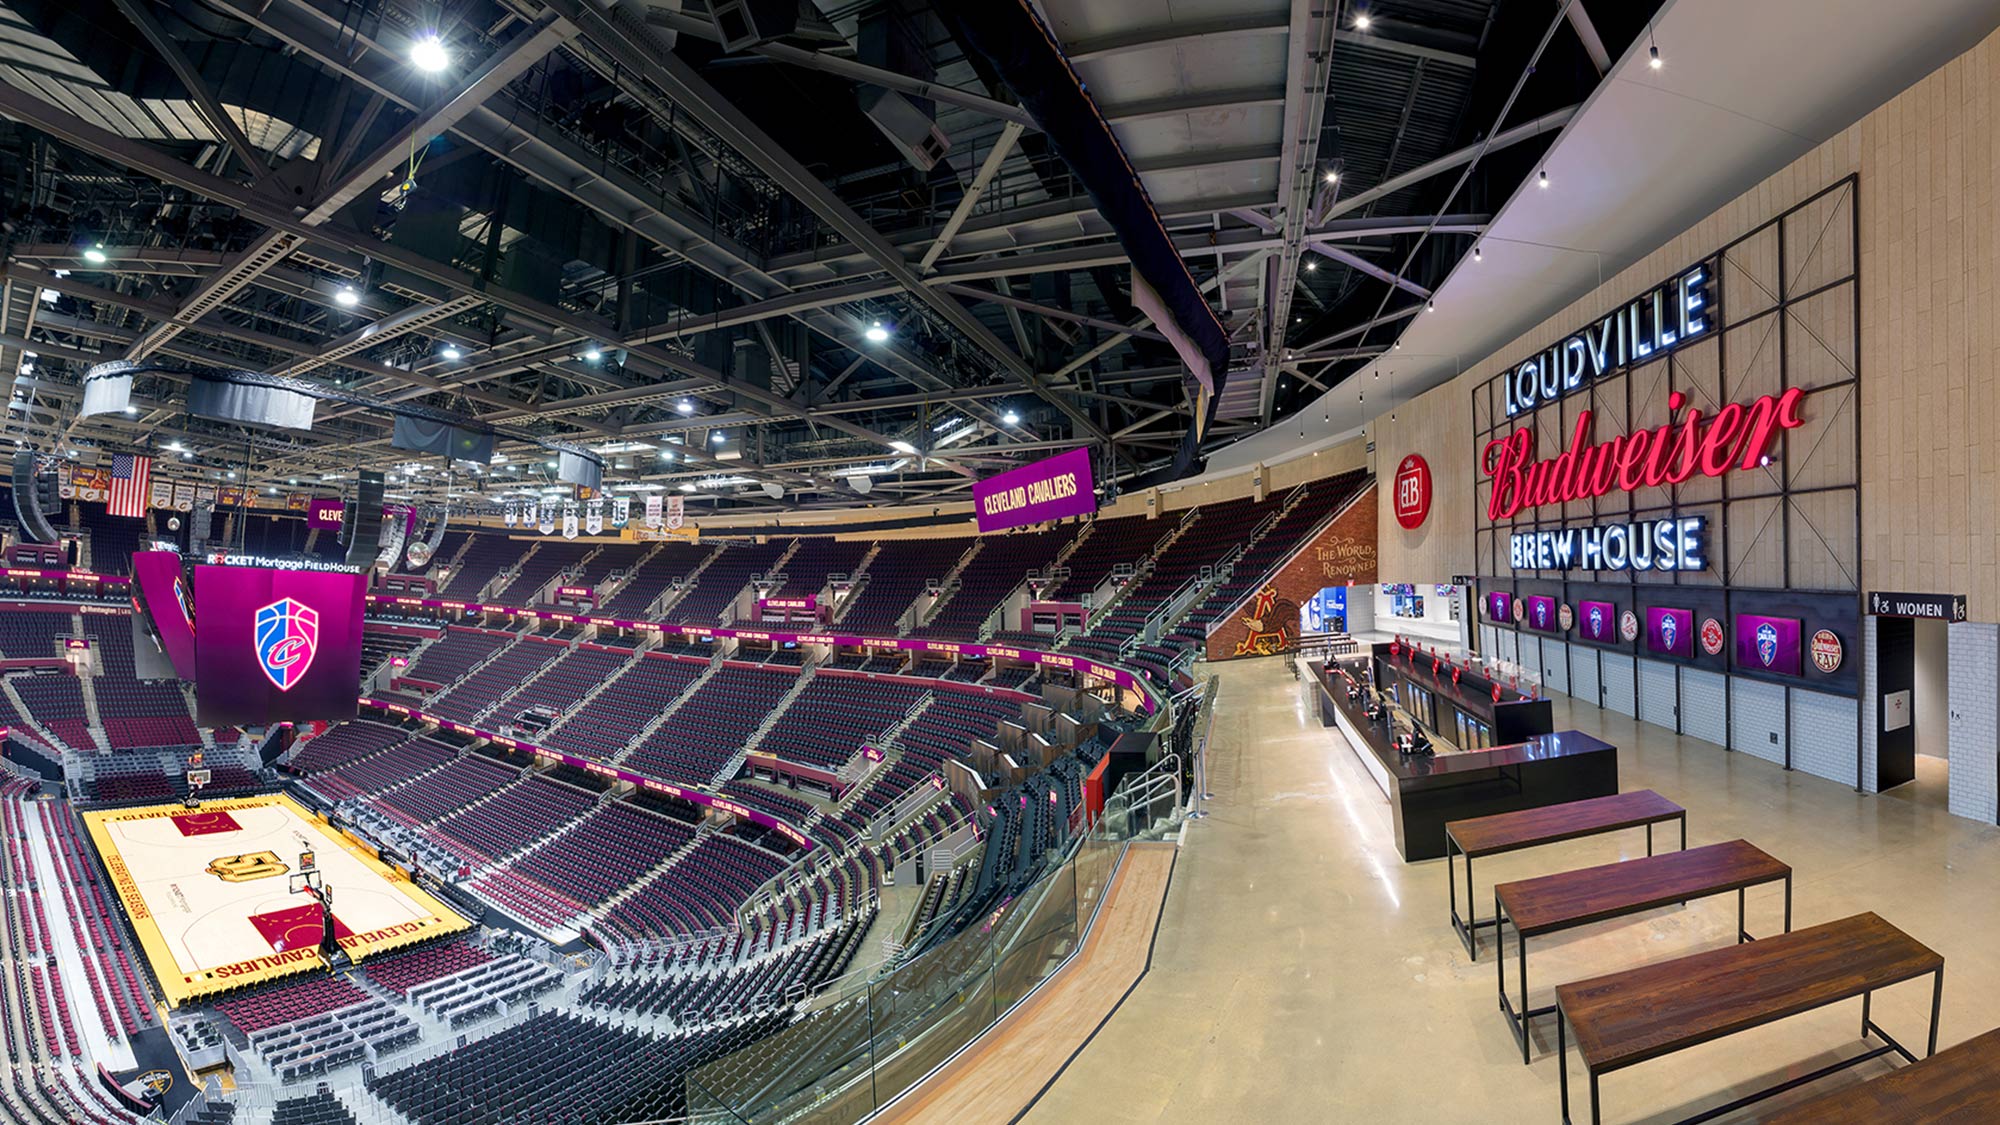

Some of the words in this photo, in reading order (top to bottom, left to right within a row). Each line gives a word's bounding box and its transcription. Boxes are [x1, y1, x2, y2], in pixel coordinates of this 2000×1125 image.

[1504, 264, 1710, 416] LOUDVILLE
[1482, 386, 1805, 521] Budweiser
[984, 486, 1027, 515] CLEVELAND
[1027, 472, 1077, 505] CAVALIERS
[1401, 476, 1419, 508] AB
[1315, 546, 1336, 561] THE
[1336, 543, 1376, 560] WORLD
[1510, 527, 1575, 571] BREW
[1580, 516, 1708, 571] HOUSE
[207, 553, 254, 566] ROCKET
[255, 556, 303, 571] Mortgage
[1323, 560, 1376, 579] RENOWNED
[1896, 602, 1943, 617] WOMEN
[200, 801, 264, 814] CAVALIERS
[338, 923, 419, 950] CLEVELA
[215, 948, 316, 979] CAVALIERS
